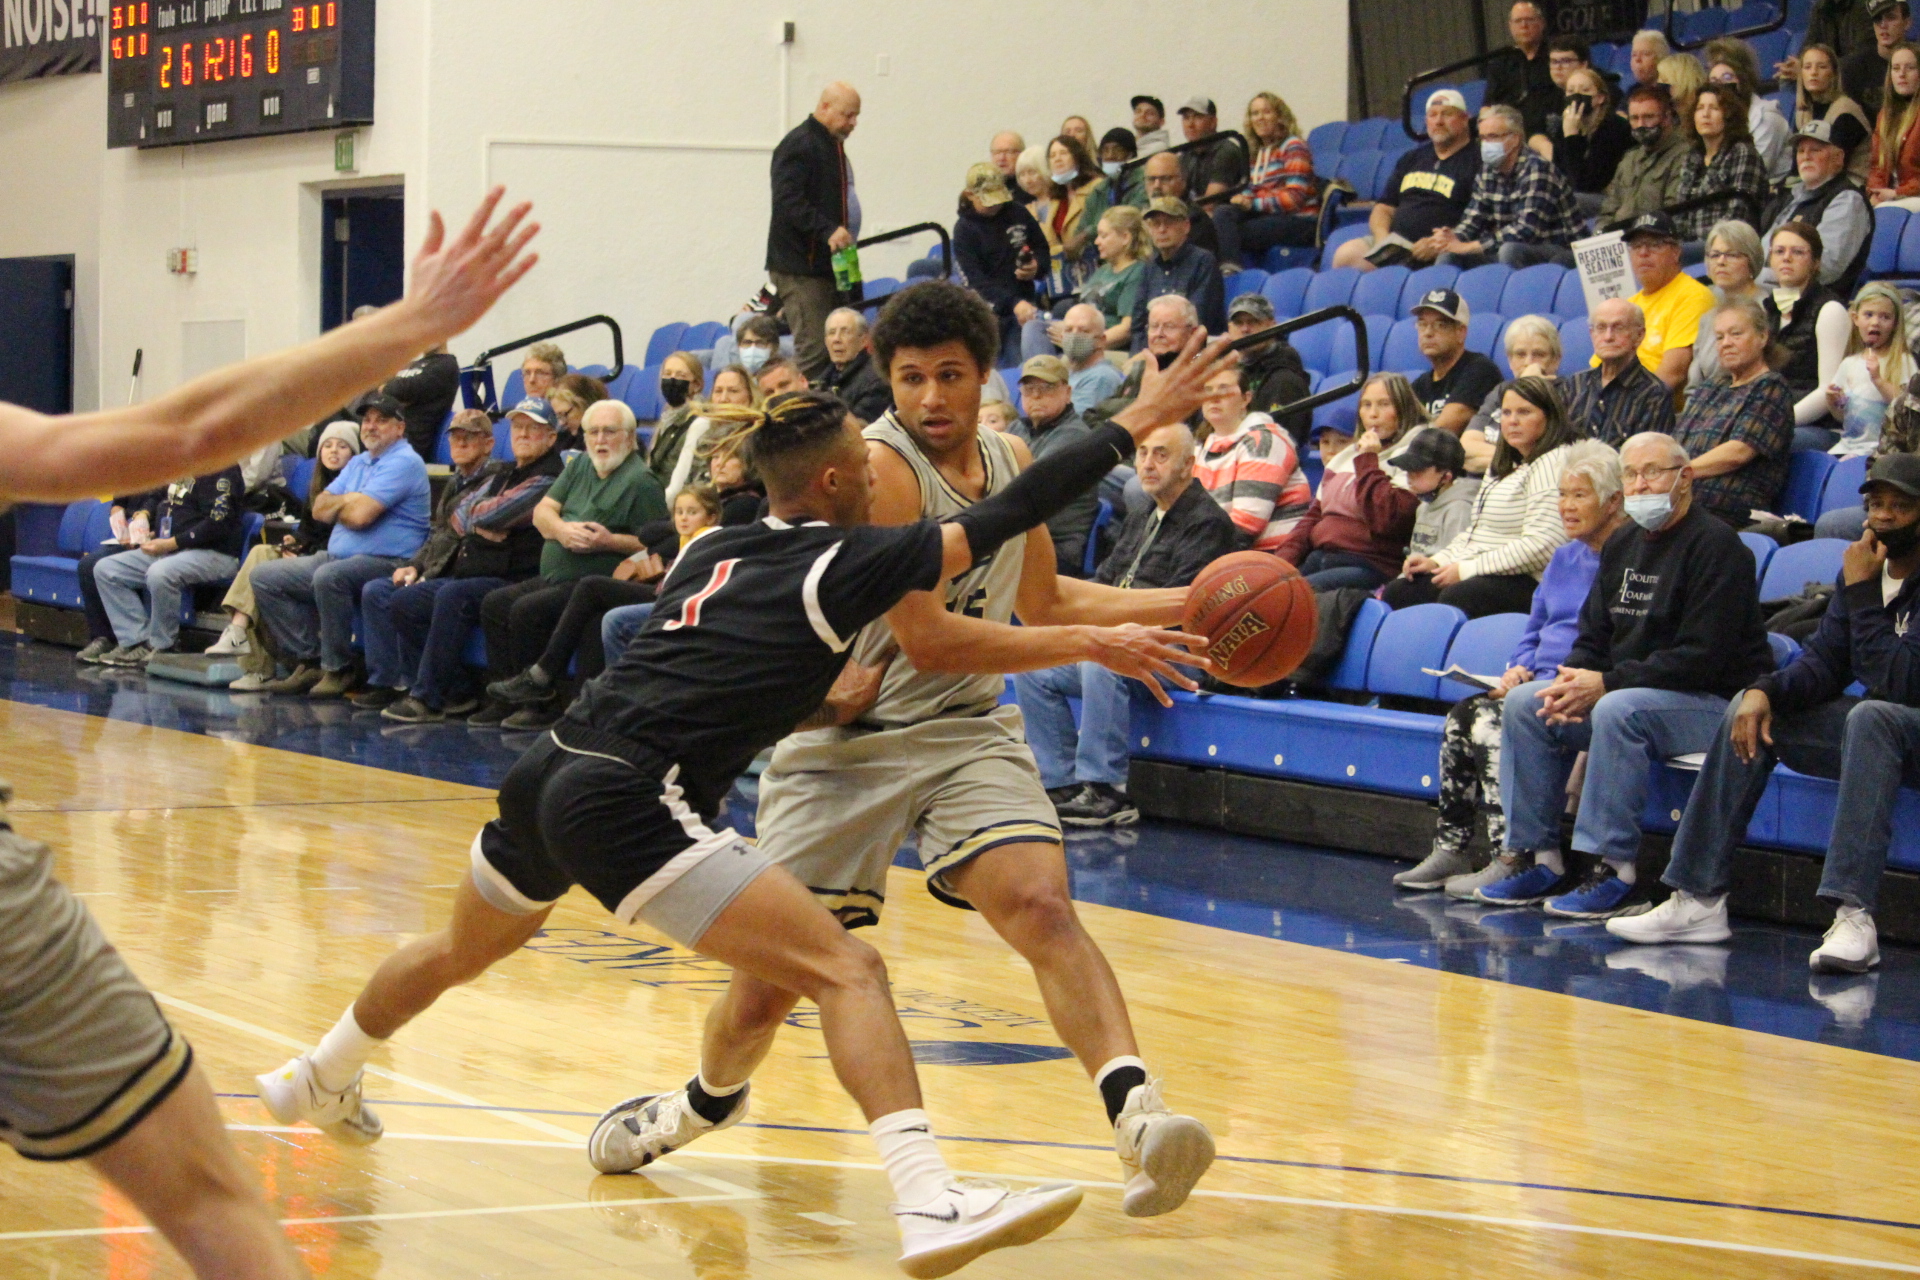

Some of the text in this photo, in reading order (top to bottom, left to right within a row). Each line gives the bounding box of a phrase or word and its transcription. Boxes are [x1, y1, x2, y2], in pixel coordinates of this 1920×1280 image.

[1577, 242, 1625, 265] RESERVED
[1584, 255, 1624, 275] SEATING
[662, 557, 742, 631] 1
[1207, 611, 1270, 671] NAIA
